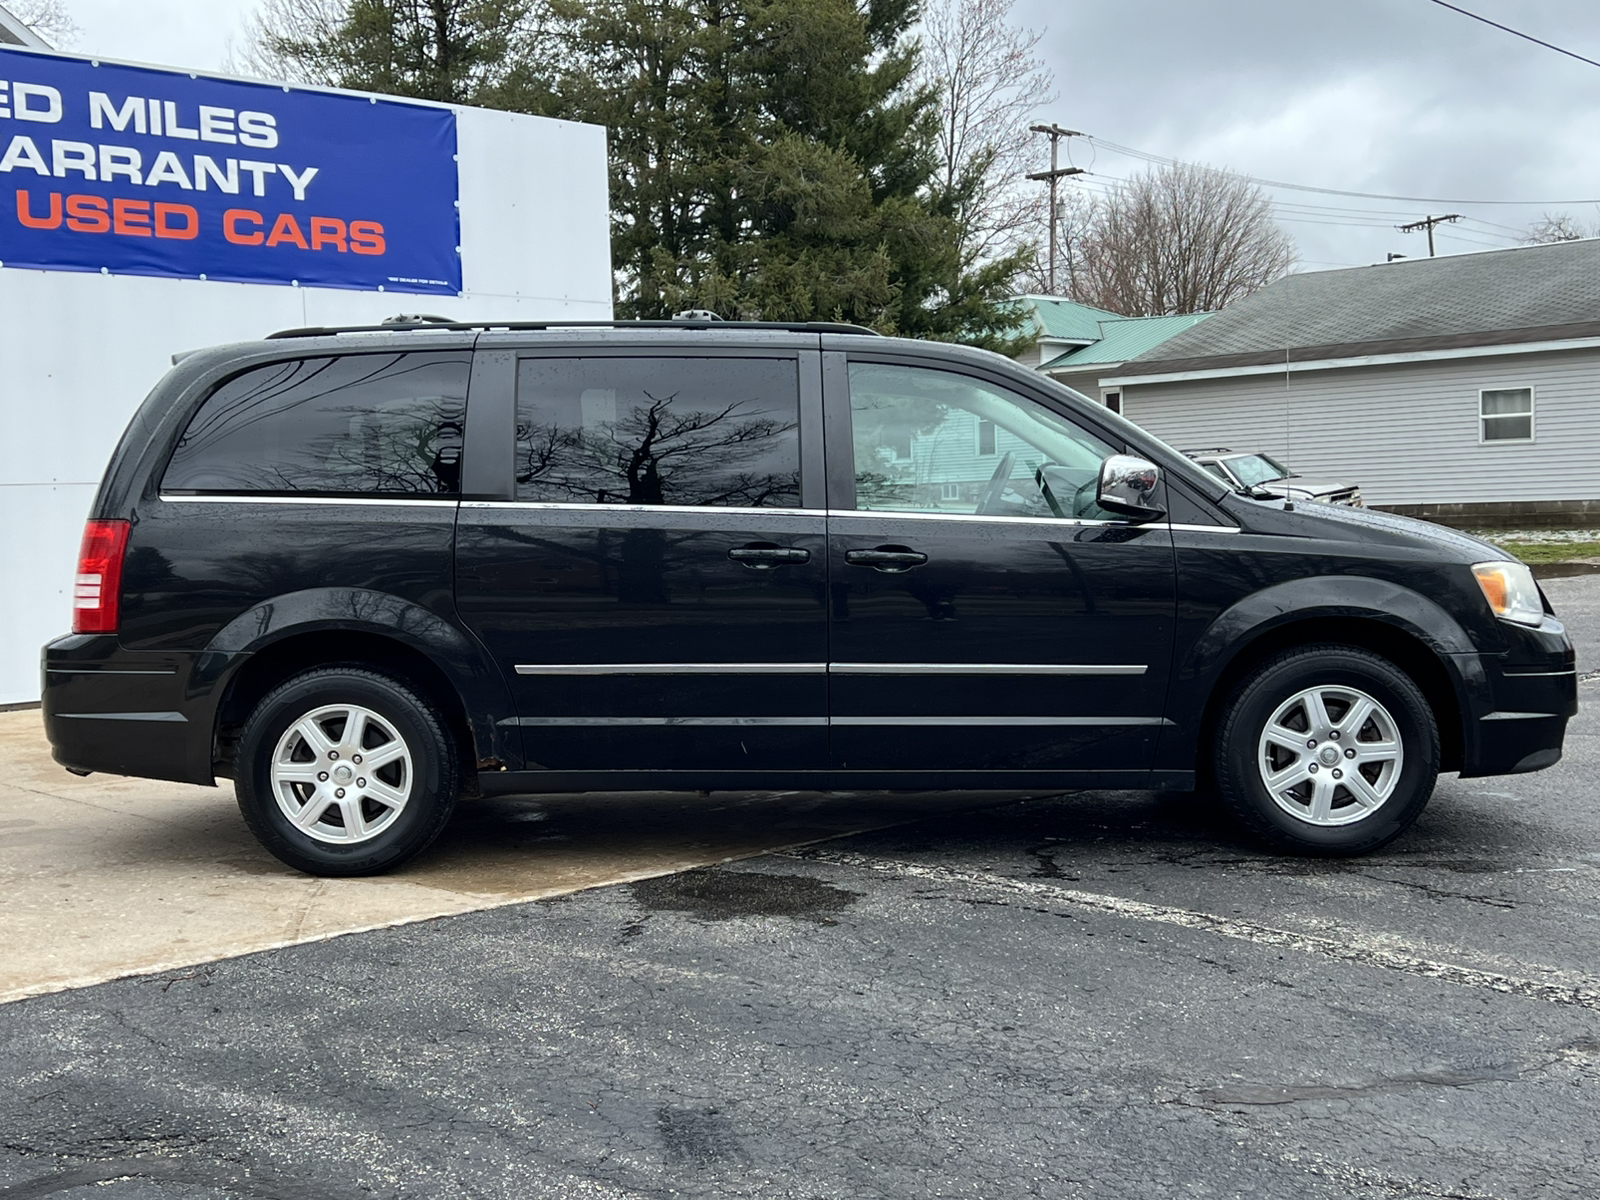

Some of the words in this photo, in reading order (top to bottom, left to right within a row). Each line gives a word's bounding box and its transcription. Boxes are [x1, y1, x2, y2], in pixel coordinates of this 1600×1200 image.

[0, 79, 62, 123] D
[89, 91, 279, 149] MILES
[0, 135, 319, 201] ARRANTY
[17, 190, 199, 240] USED
[223, 209, 386, 256] CARS
